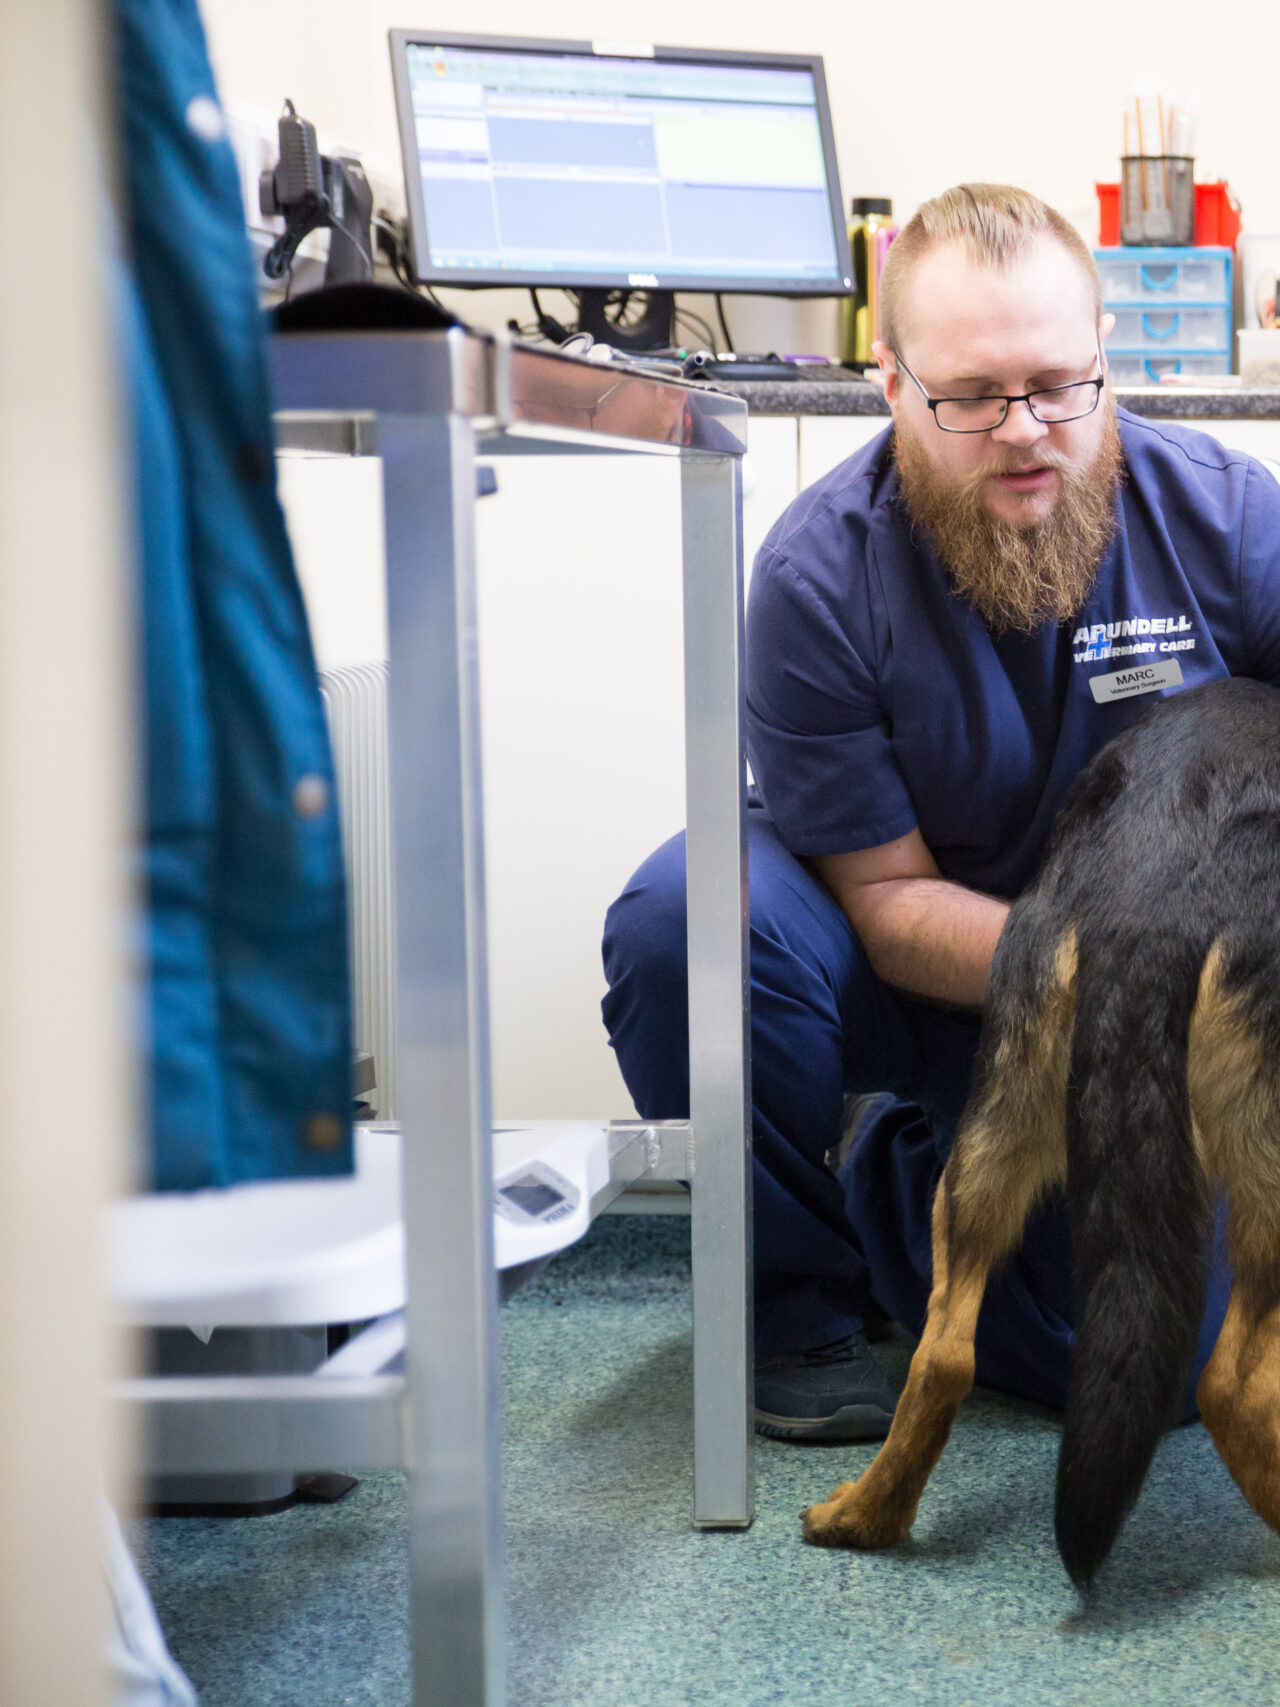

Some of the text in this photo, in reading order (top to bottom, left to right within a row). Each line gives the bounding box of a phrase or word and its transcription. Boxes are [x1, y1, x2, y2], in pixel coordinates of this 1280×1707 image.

[1073, 615, 1192, 645] ARUNDELL
[1159, 639, 1196, 653] CARE
[1115, 669, 1155, 686] MARC
[1110, 679, 1167, 695] Veterinary Surgeon
